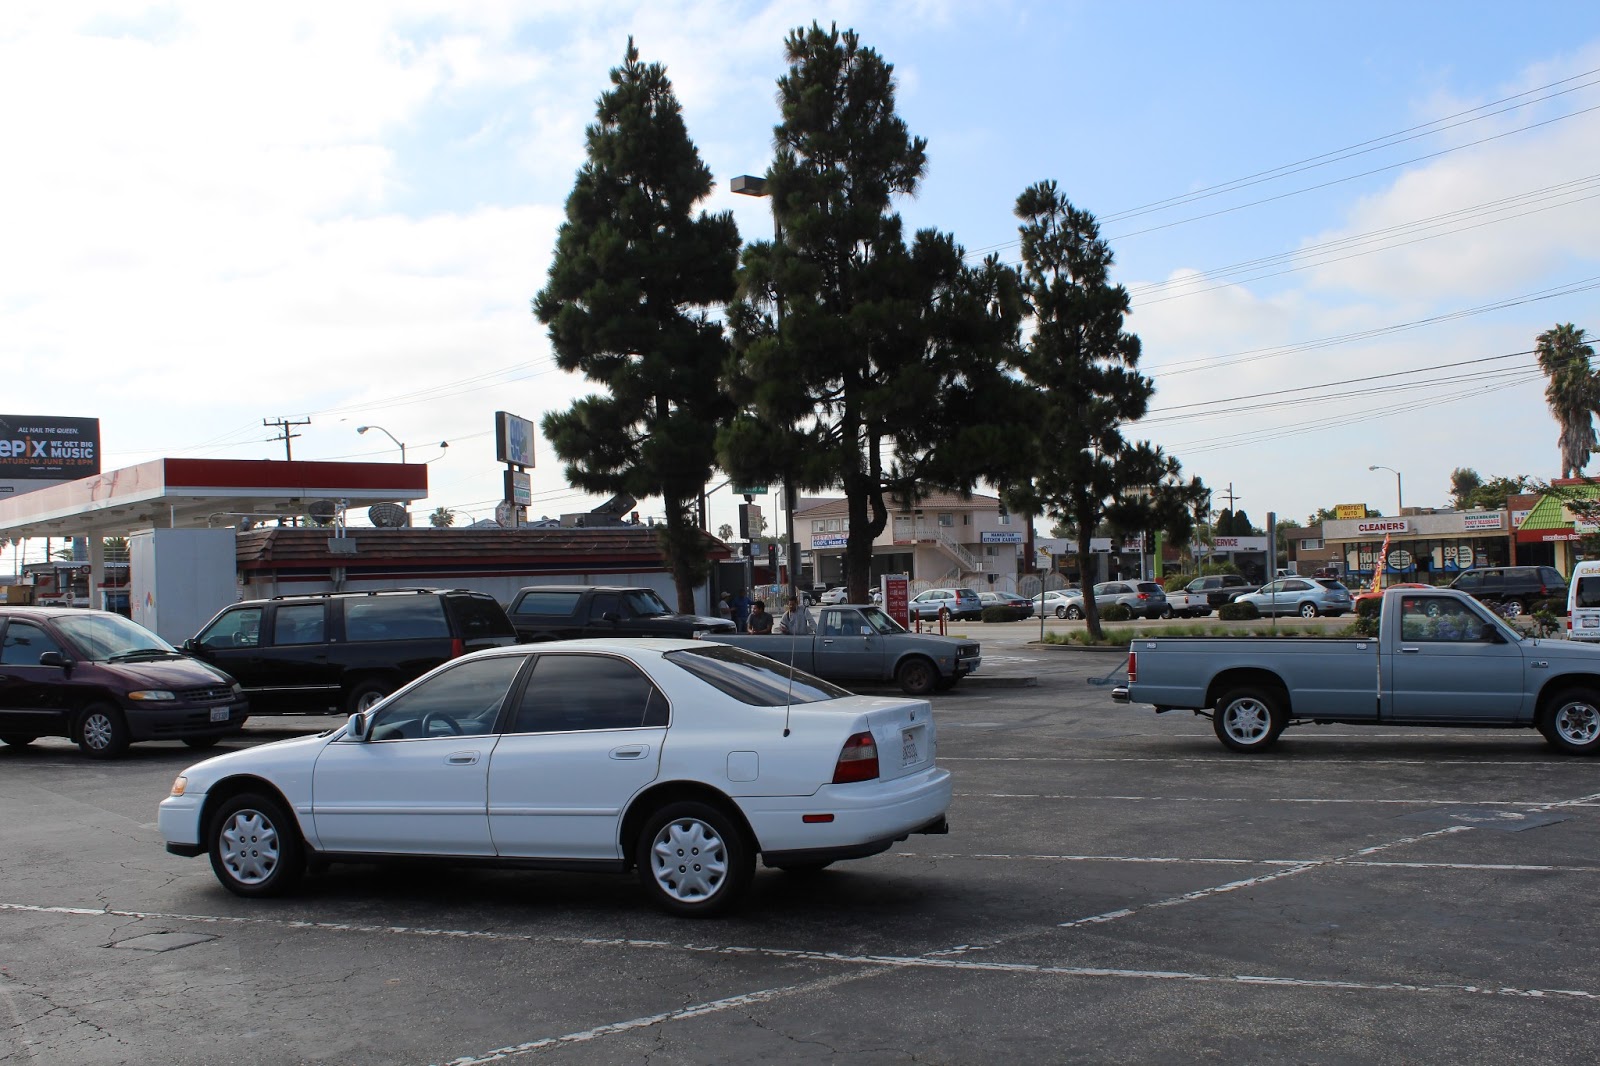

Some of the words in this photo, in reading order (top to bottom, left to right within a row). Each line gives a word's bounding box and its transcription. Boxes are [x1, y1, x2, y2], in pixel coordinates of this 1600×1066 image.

[51, 447, 93, 458] MUSIC
[1358, 522, 1405, 531] CLEANERS
[1214, 538, 1238, 547] SERVICE
[1444, 547, 1457, 557] 89
